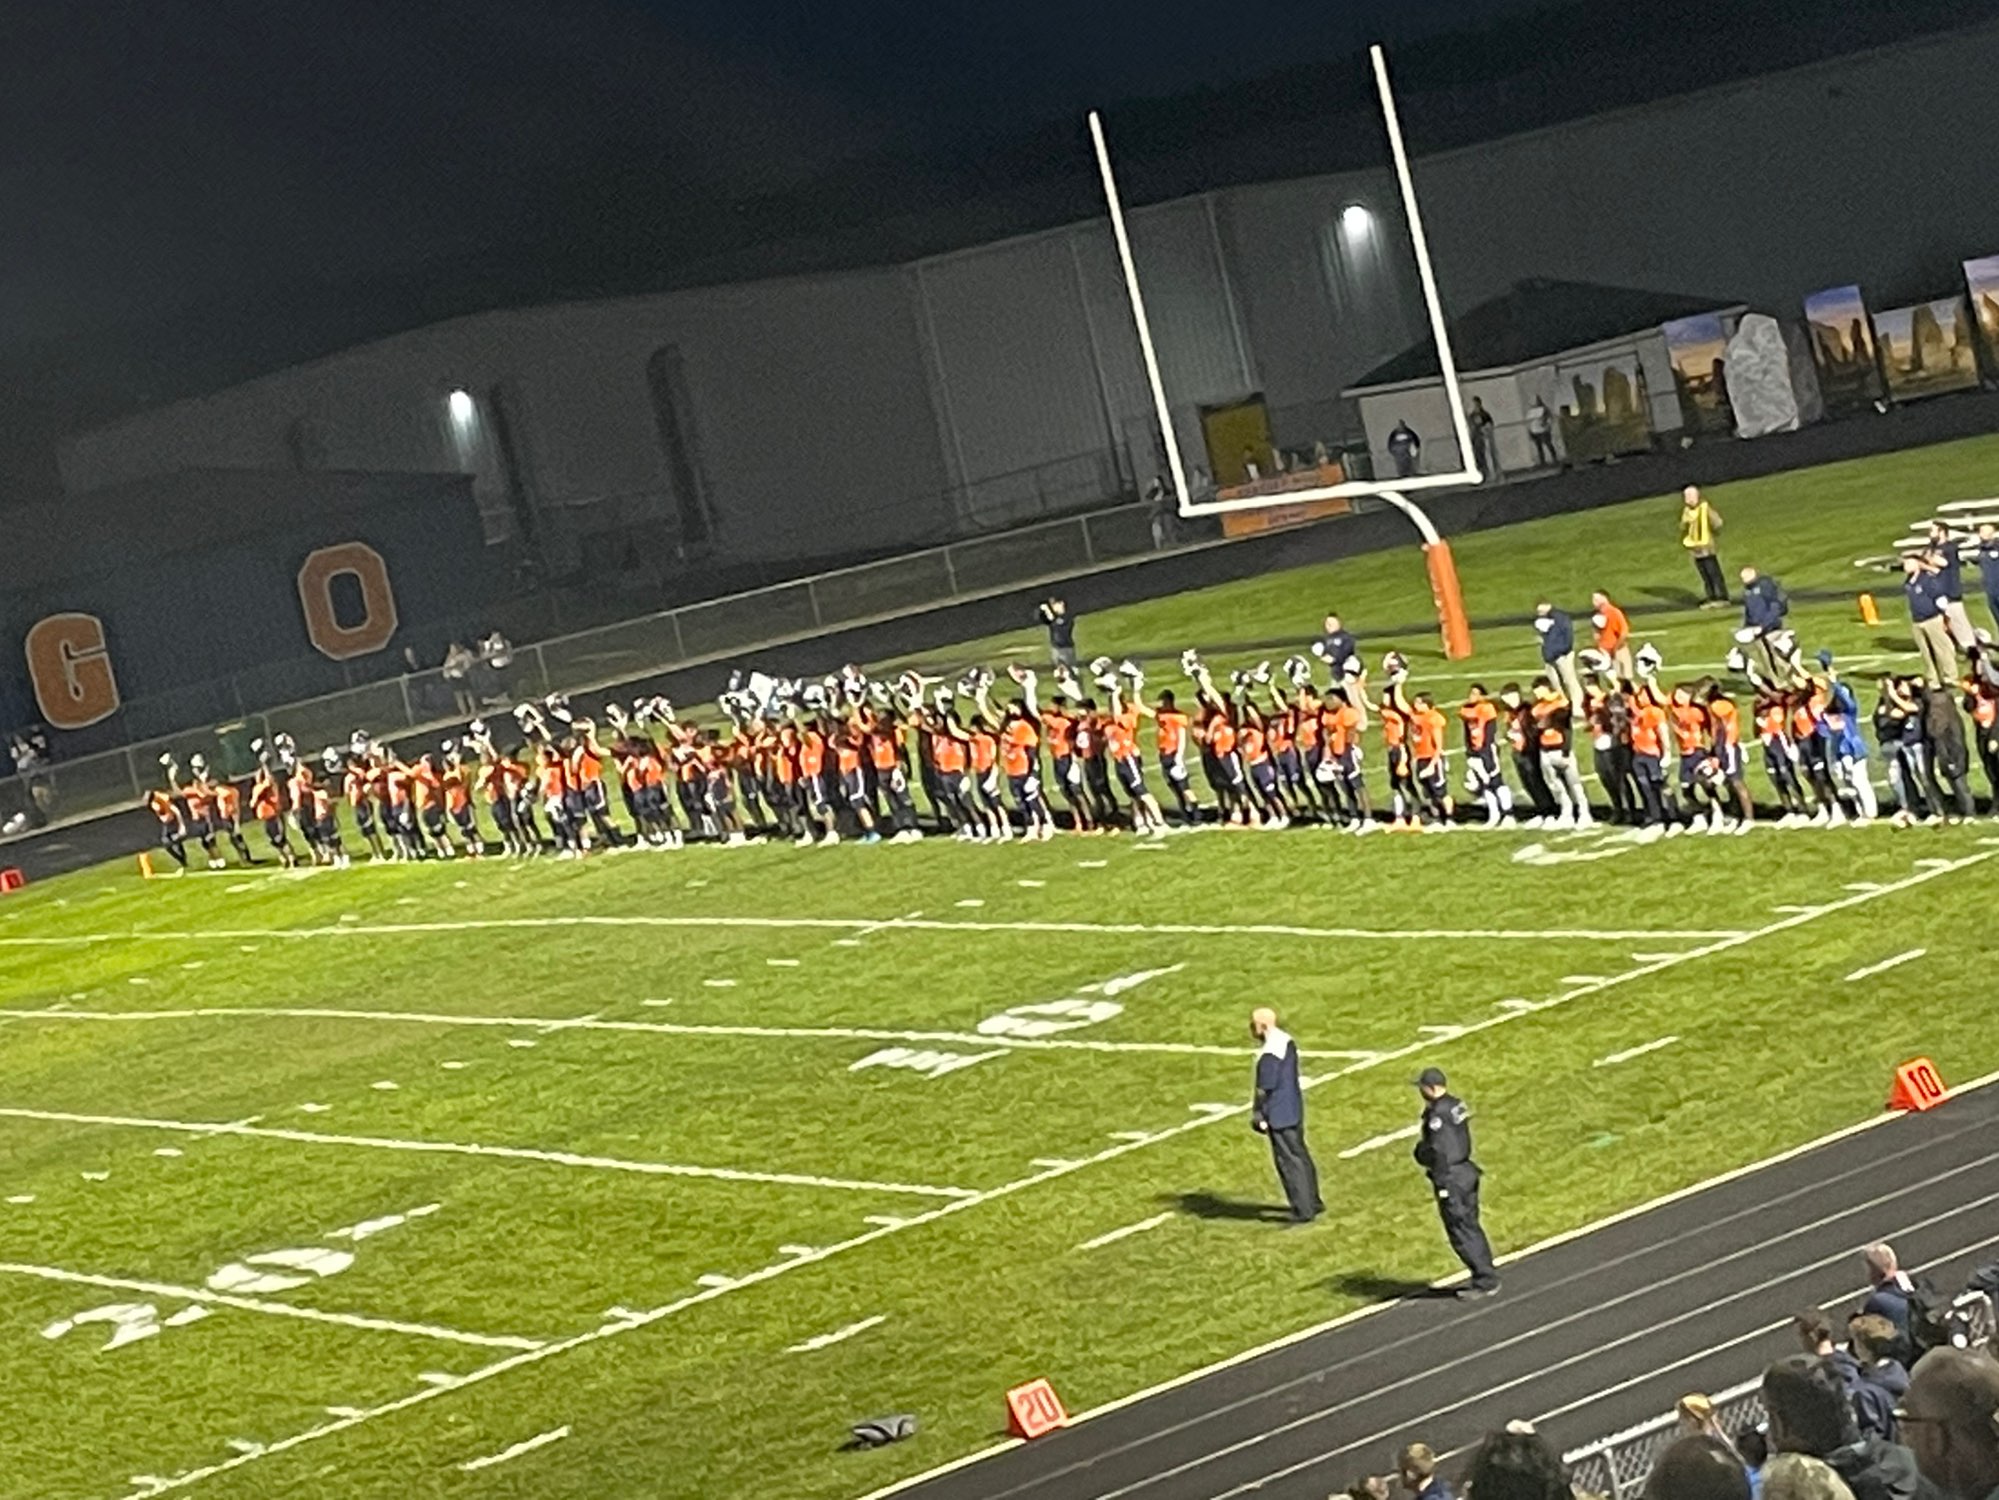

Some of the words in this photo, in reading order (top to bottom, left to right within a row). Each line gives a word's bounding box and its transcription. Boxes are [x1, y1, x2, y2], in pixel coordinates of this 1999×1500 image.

[25, 612, 120, 730] G
[298, 541, 398, 660] O
[1907, 1065, 1942, 1102] 10
[1017, 1387, 1060, 1430] 20
